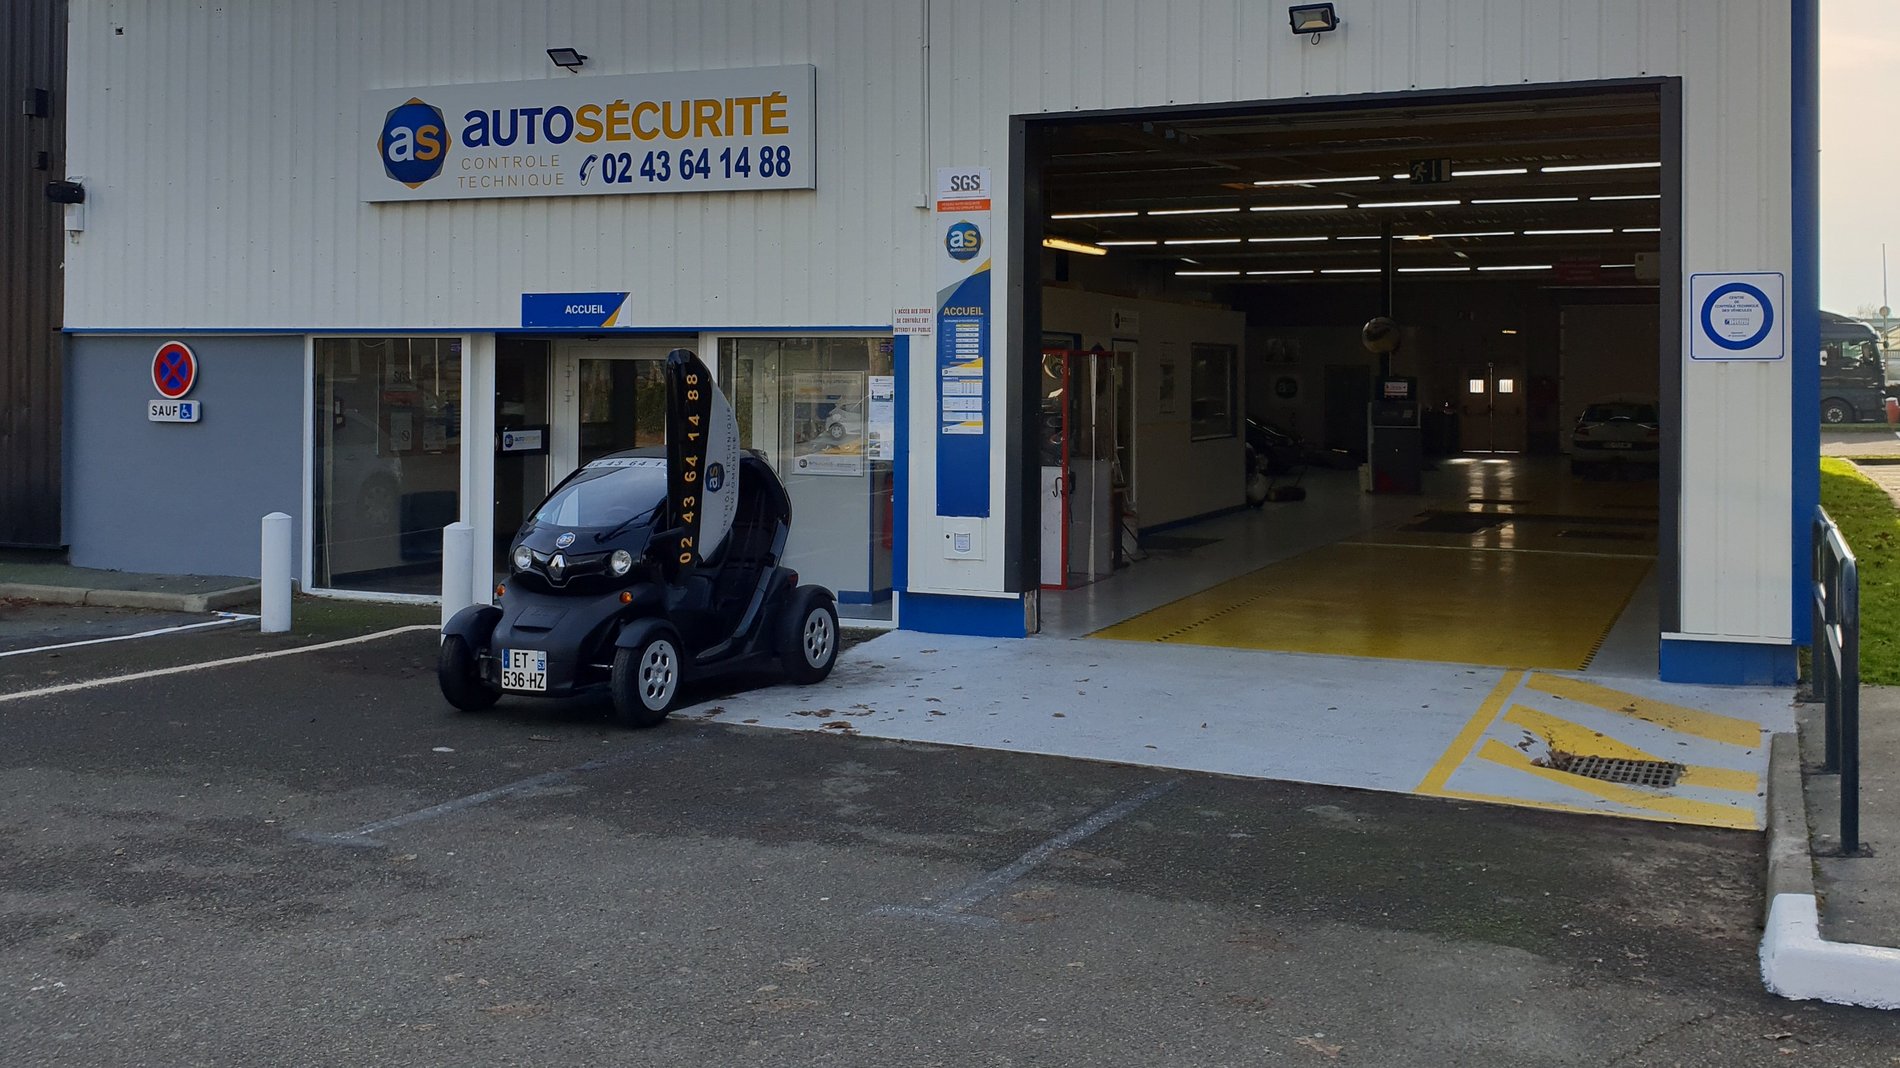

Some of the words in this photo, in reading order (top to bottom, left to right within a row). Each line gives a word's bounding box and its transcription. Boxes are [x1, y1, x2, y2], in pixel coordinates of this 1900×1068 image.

[387, 124, 441, 163] as
[461, 154, 561, 171] CONTROLE
[602, 151, 633, 184] 02
[640, 149, 671, 183] 43
[679, 148, 711, 180] 64
[719, 146, 751, 179] 14
[759, 145, 791, 178] 88
[457, 172, 565, 189] TECHNIQUE
[950, 174, 980, 192] SGS
[949, 230, 977, 248] as
[564, 304, 606, 314] ACCUEIL
[943, 306, 984, 316] ACCUEIL
[685, 372, 700, 402] 88
[151, 405, 178, 417] SAUF
[686, 412, 701, 442] 14
[684, 454, 699, 483] 64
[682, 495, 696, 525] 43
[680, 535, 693, 565] 02
[503, 671, 545, 690] 536-HZ
